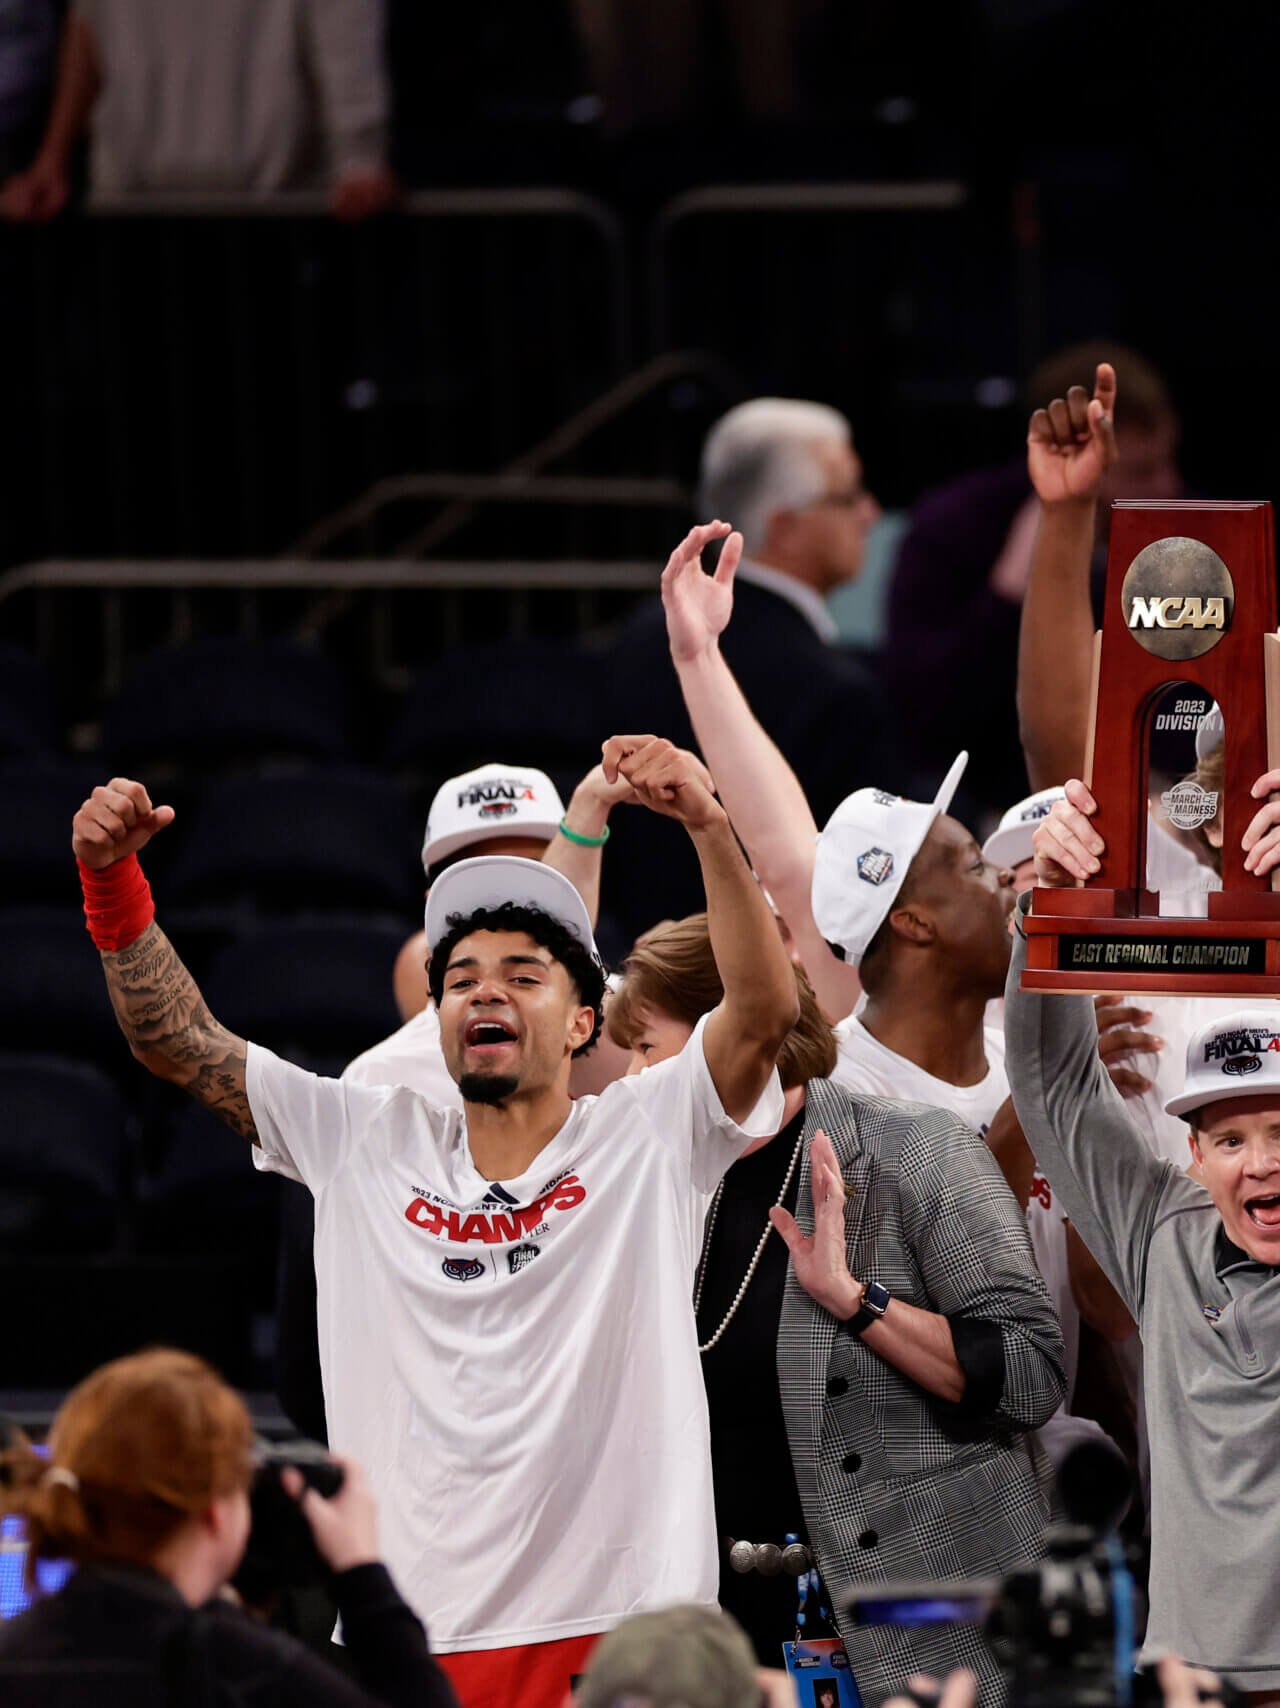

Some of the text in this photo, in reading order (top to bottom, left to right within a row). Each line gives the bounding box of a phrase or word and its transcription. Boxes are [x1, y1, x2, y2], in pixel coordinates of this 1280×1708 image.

[1129, 597, 1225, 629] NCAA
[1175, 700, 1206, 714] 2023
[1155, 715, 1217, 730] DIVISION
[1171, 794, 1202, 804] MARCH
[1174, 804, 1216, 815] MADNESS
[1072, 943, 1250, 965] EAST REGIONAL CHAMPION
[1203, 1039, 1268, 1063] FINAL
[411, 1185, 431, 1199] 2023
[405, 1175, 586, 1244] CHAMPS
[513, 1249, 536, 1264] FINAL
